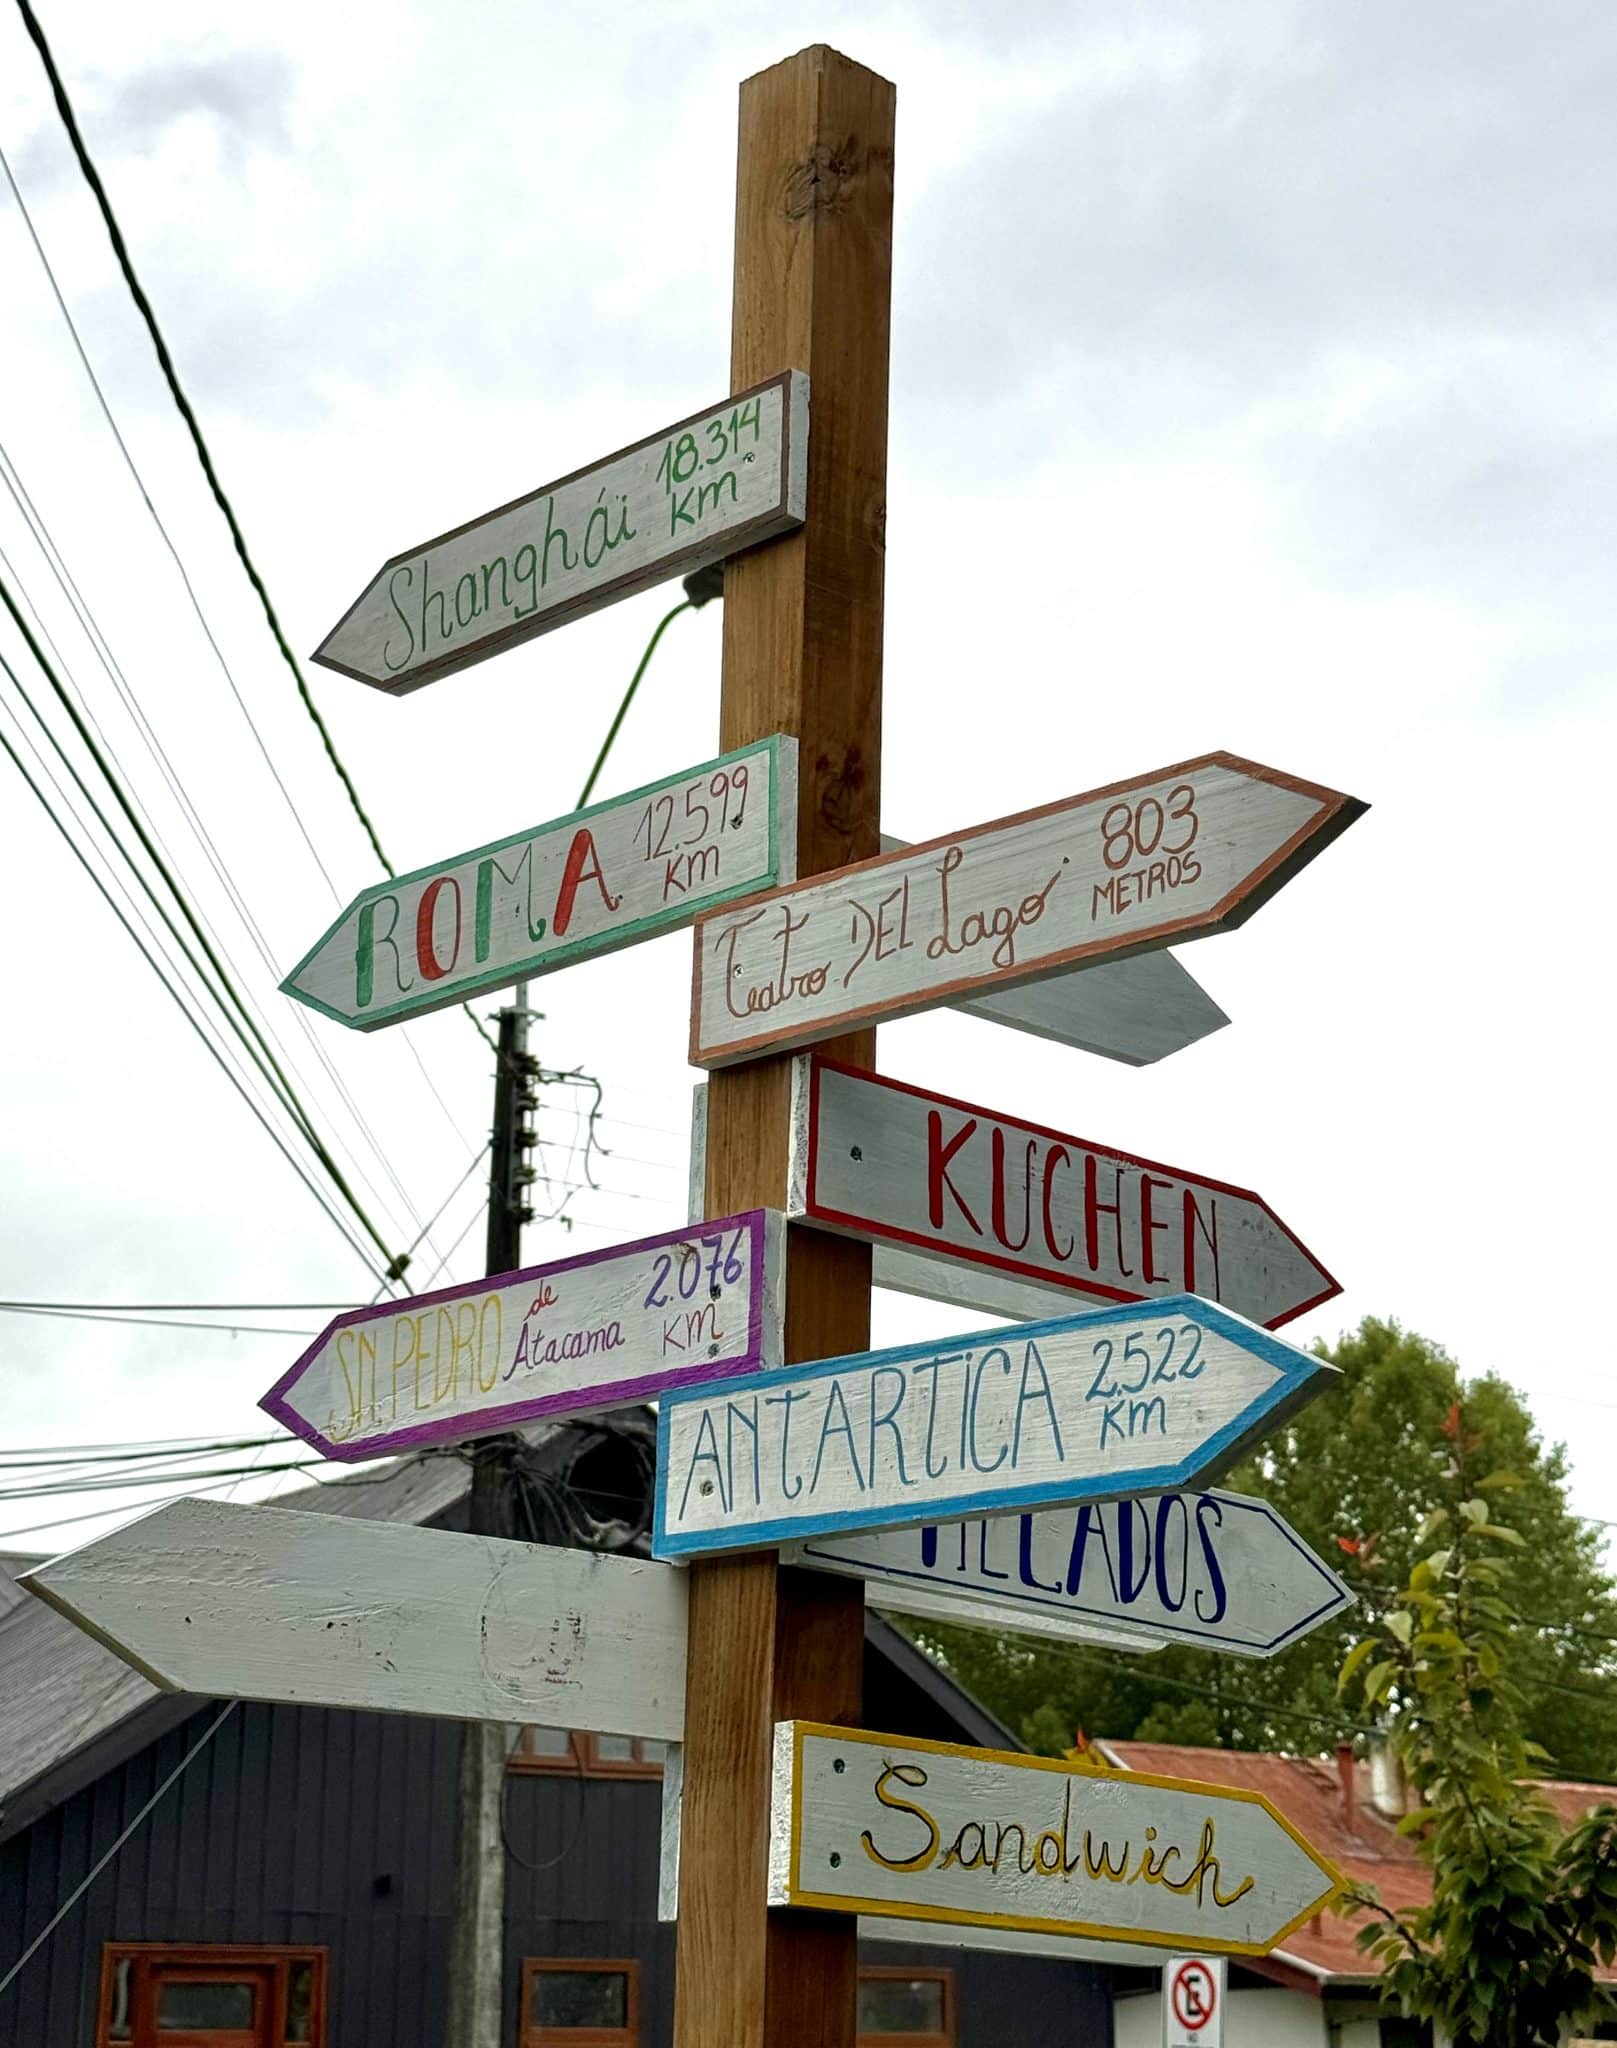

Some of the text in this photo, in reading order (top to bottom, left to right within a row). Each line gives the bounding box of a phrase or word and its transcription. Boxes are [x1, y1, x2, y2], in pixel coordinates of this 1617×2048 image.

[656, 397, 761, 495] 18.314
[633, 765, 748, 861] 12.599
[1101, 784, 1199, 870] 803
[355, 828, 623, 1007] ROMA
[715, 846, 1062, 1018] Teatro DEL Lago
[1091, 855, 1202, 920] METROS
[927, 1109, 1220, 1302] KUCHEN
[523, 1279, 559, 1322] de
[644, 1227, 743, 1310] 2.076
[392, 1294, 502, 1420] PEDRO
[502, 1320, 626, 1382] Atacama
[1085, 1324, 1205, 1401] 2.522
[859, 1759, 1255, 1908] Sandwich
